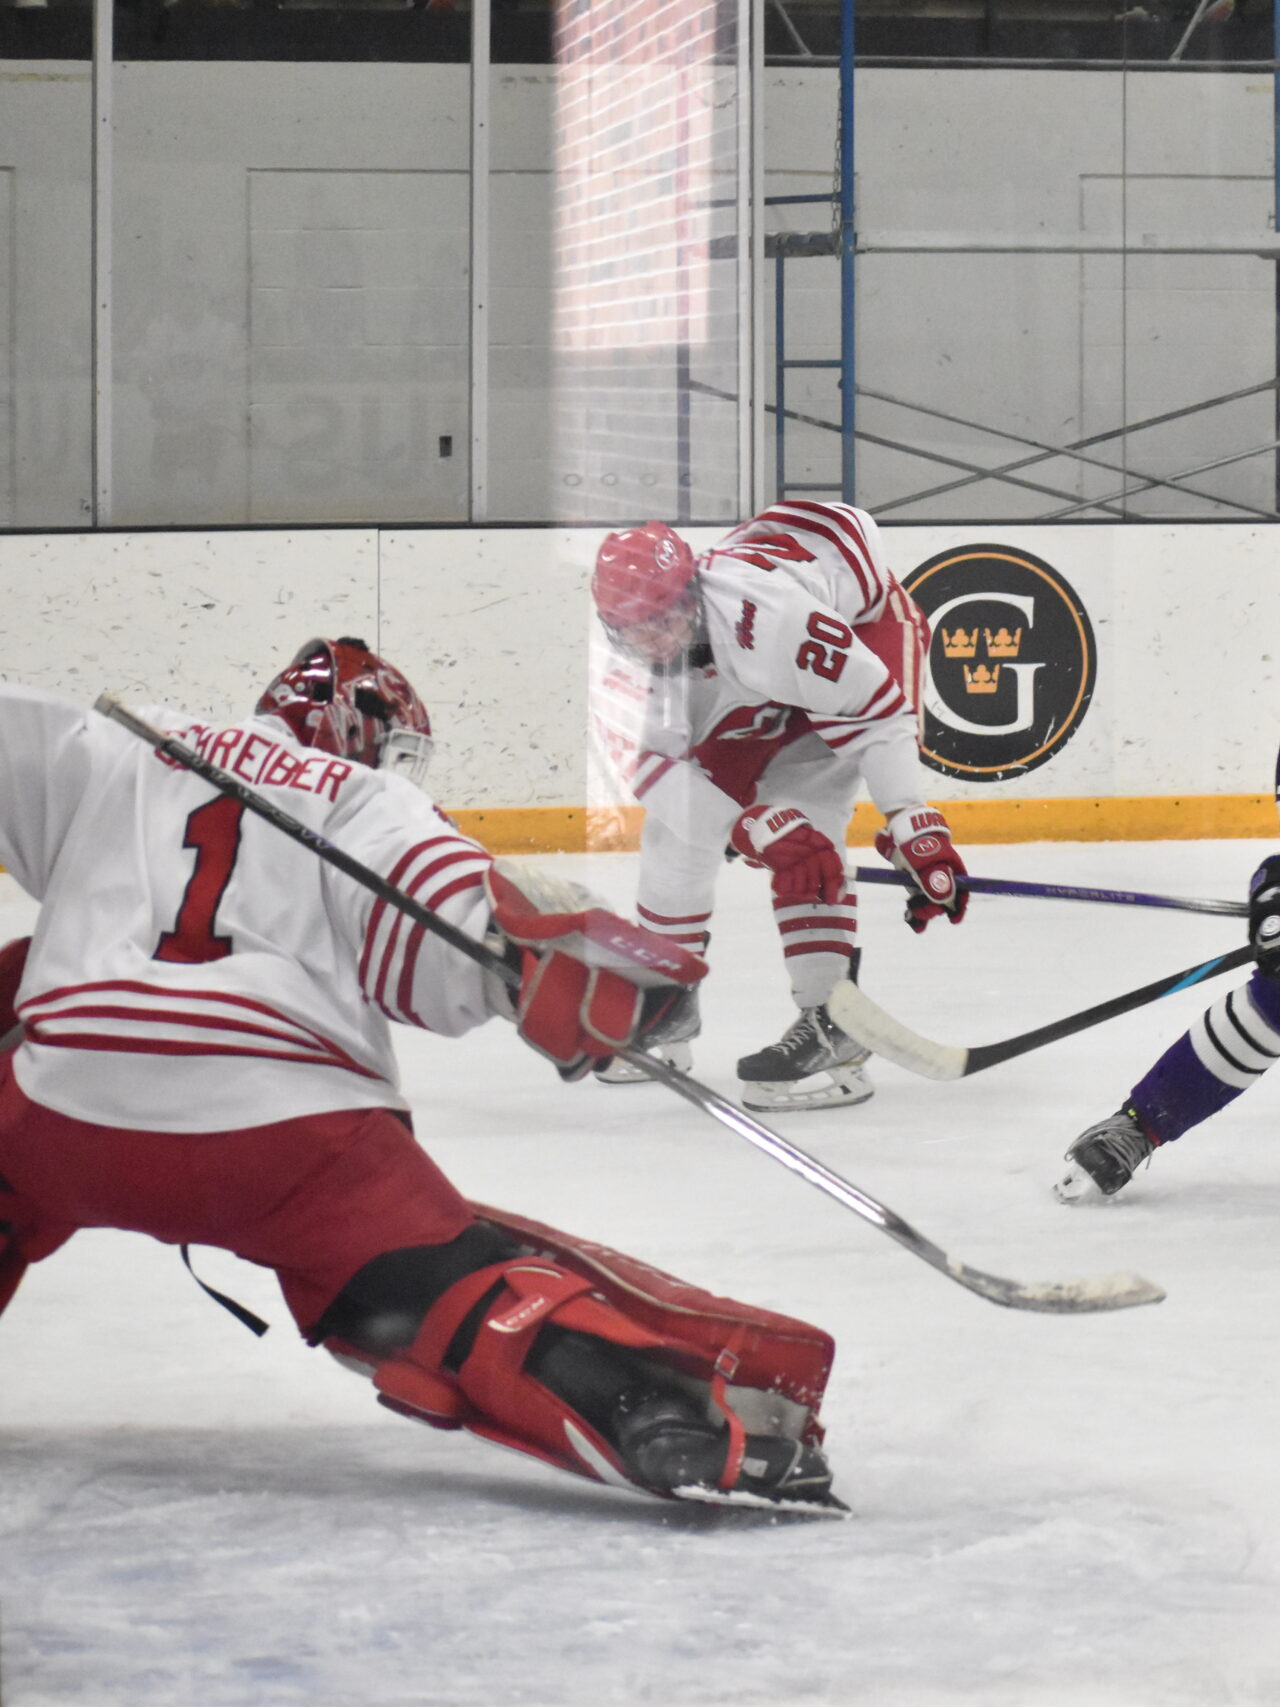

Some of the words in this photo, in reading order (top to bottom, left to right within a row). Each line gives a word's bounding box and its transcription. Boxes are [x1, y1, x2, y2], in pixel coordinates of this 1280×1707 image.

[796, 611, 853, 684] 20
[923, 591, 1047, 737] G
[151, 792, 246, 964] 1
